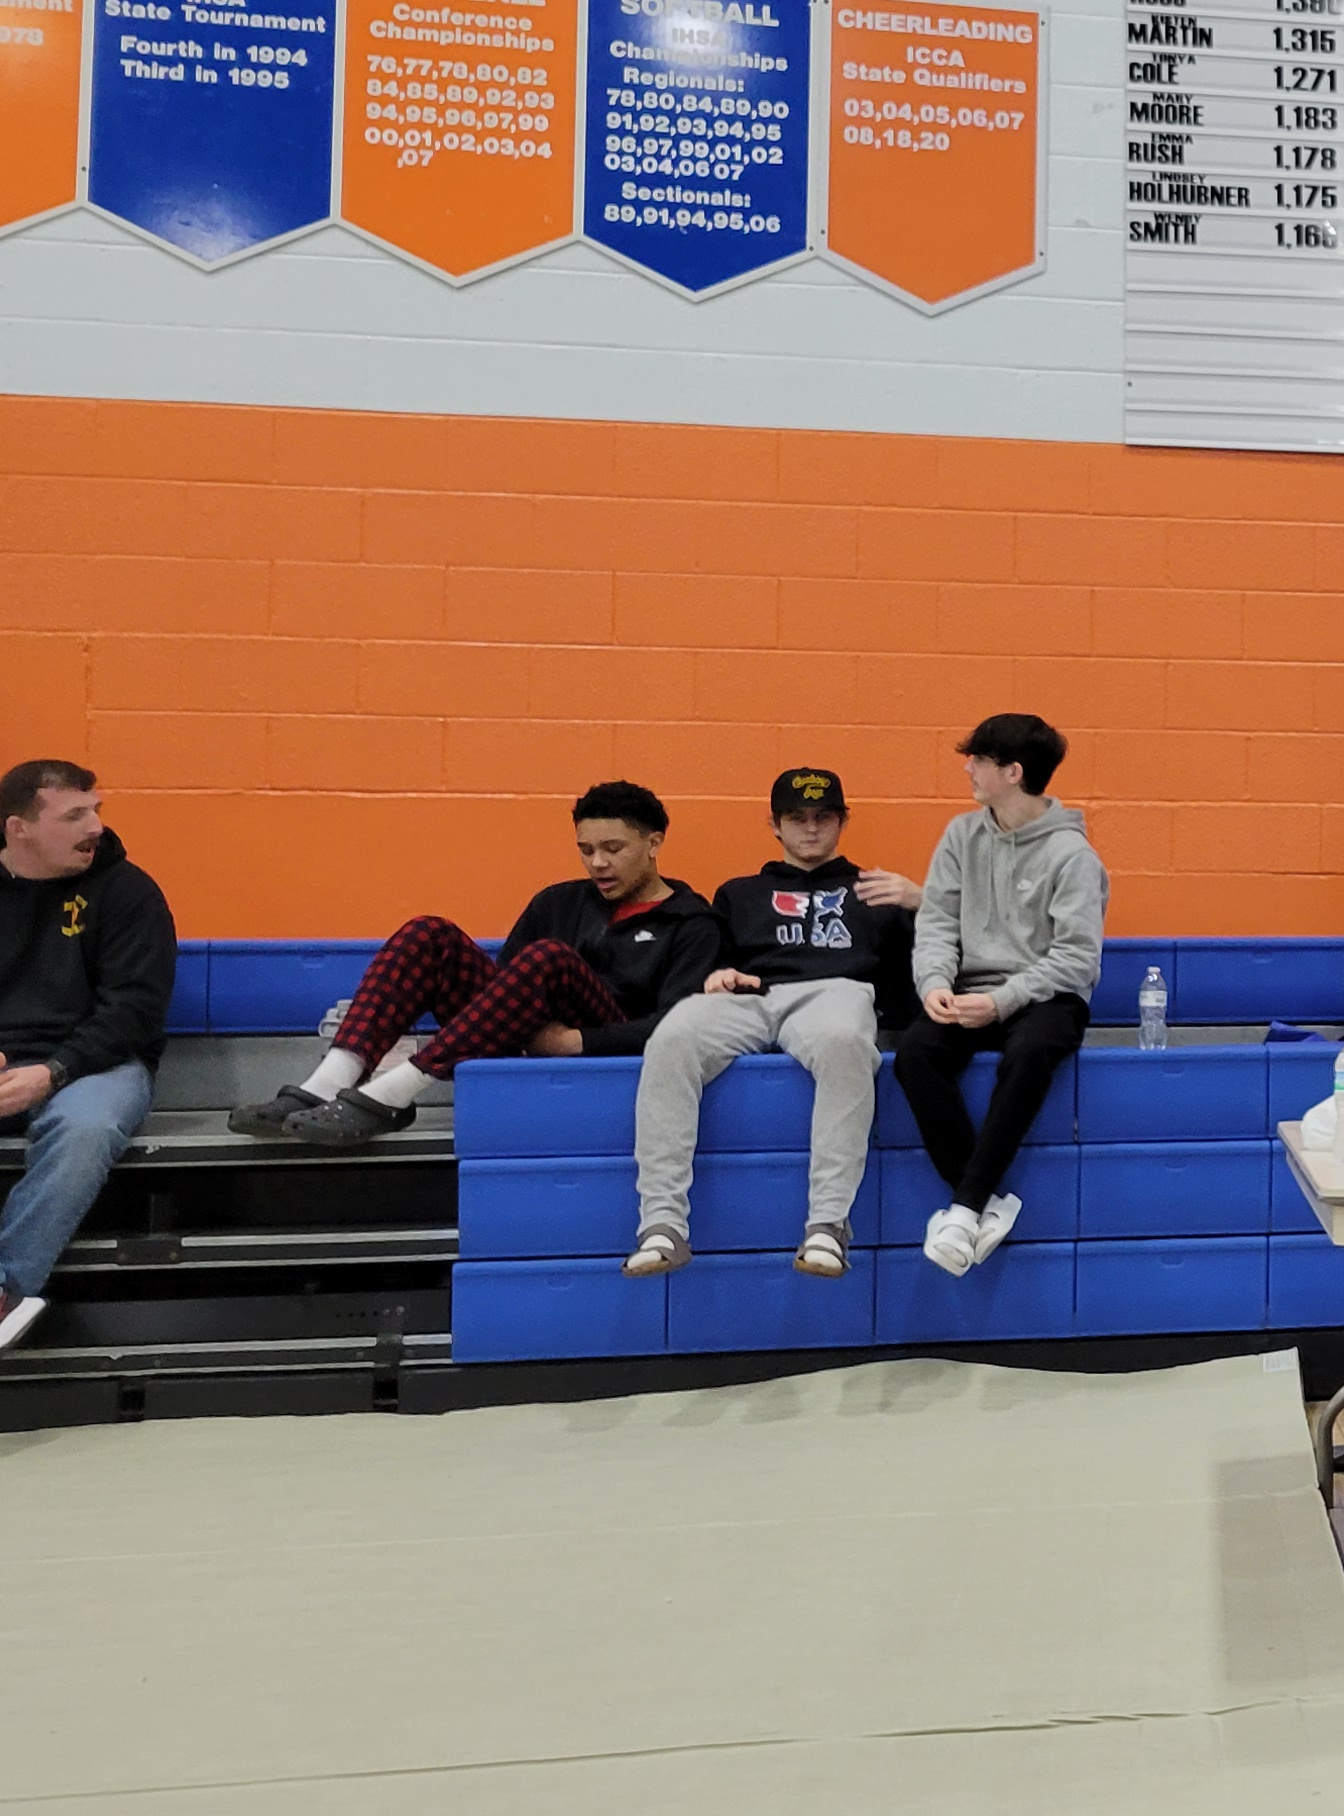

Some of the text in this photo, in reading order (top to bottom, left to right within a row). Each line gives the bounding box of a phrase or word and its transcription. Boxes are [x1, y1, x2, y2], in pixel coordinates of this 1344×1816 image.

[104, 0, 327, 33] State Tournament
[393, 3, 533, 31] Conference
[620, 0, 780, 27] SOFTBALL
[837, 8, 1033, 44] CHEERLEADING
[119, 35, 203, 59] Fourth
[247, 46, 308, 67] 1994
[369, 20, 555, 53] Championships
[1127, 23, 1336, 53] MARTIN 1,315
[366, 54, 548, 86] 76,77,78,80,82
[609, 40, 788, 73] Championships
[906, 46, 966, 68] ICCA
[119, 59, 185, 81] Third
[228, 68, 290, 90] 1995
[622, 66, 745, 93] Regionals:
[842, 61, 1027, 94] State Qualifiers
[1128, 62, 1337, 93] COLE 1,271
[606, 87, 789, 120] 78,80,84,89,90
[843, 97, 1025, 131] 03,04,05,06,07
[1152, 92, 1194, 105] MARY
[605, 111, 782, 142] 91,92,93,94,95
[1129, 101, 1205, 127] MOORE
[1274, 104, 1338, 131] 1,183
[364, 126, 553, 160] 00,01,02,03,04
[605, 134, 784, 165] 96,97,99,01,02
[843, 125, 950, 152] 08,18,20
[1151, 133, 1194, 145] EMMA
[1128, 142, 1185, 165] RUSH
[1273, 145, 1338, 171] 1,178
[1152, 171, 1207, 185] LINDSEY
[621, 181, 751, 208] Sectionals:
[1128, 181, 1251, 209] HOLHUBNER
[1274, 183, 1338, 210] 1,175
[603, 203, 781, 235] 89,91,94,95,06
[1129, 220, 1198, 245] SMITH
